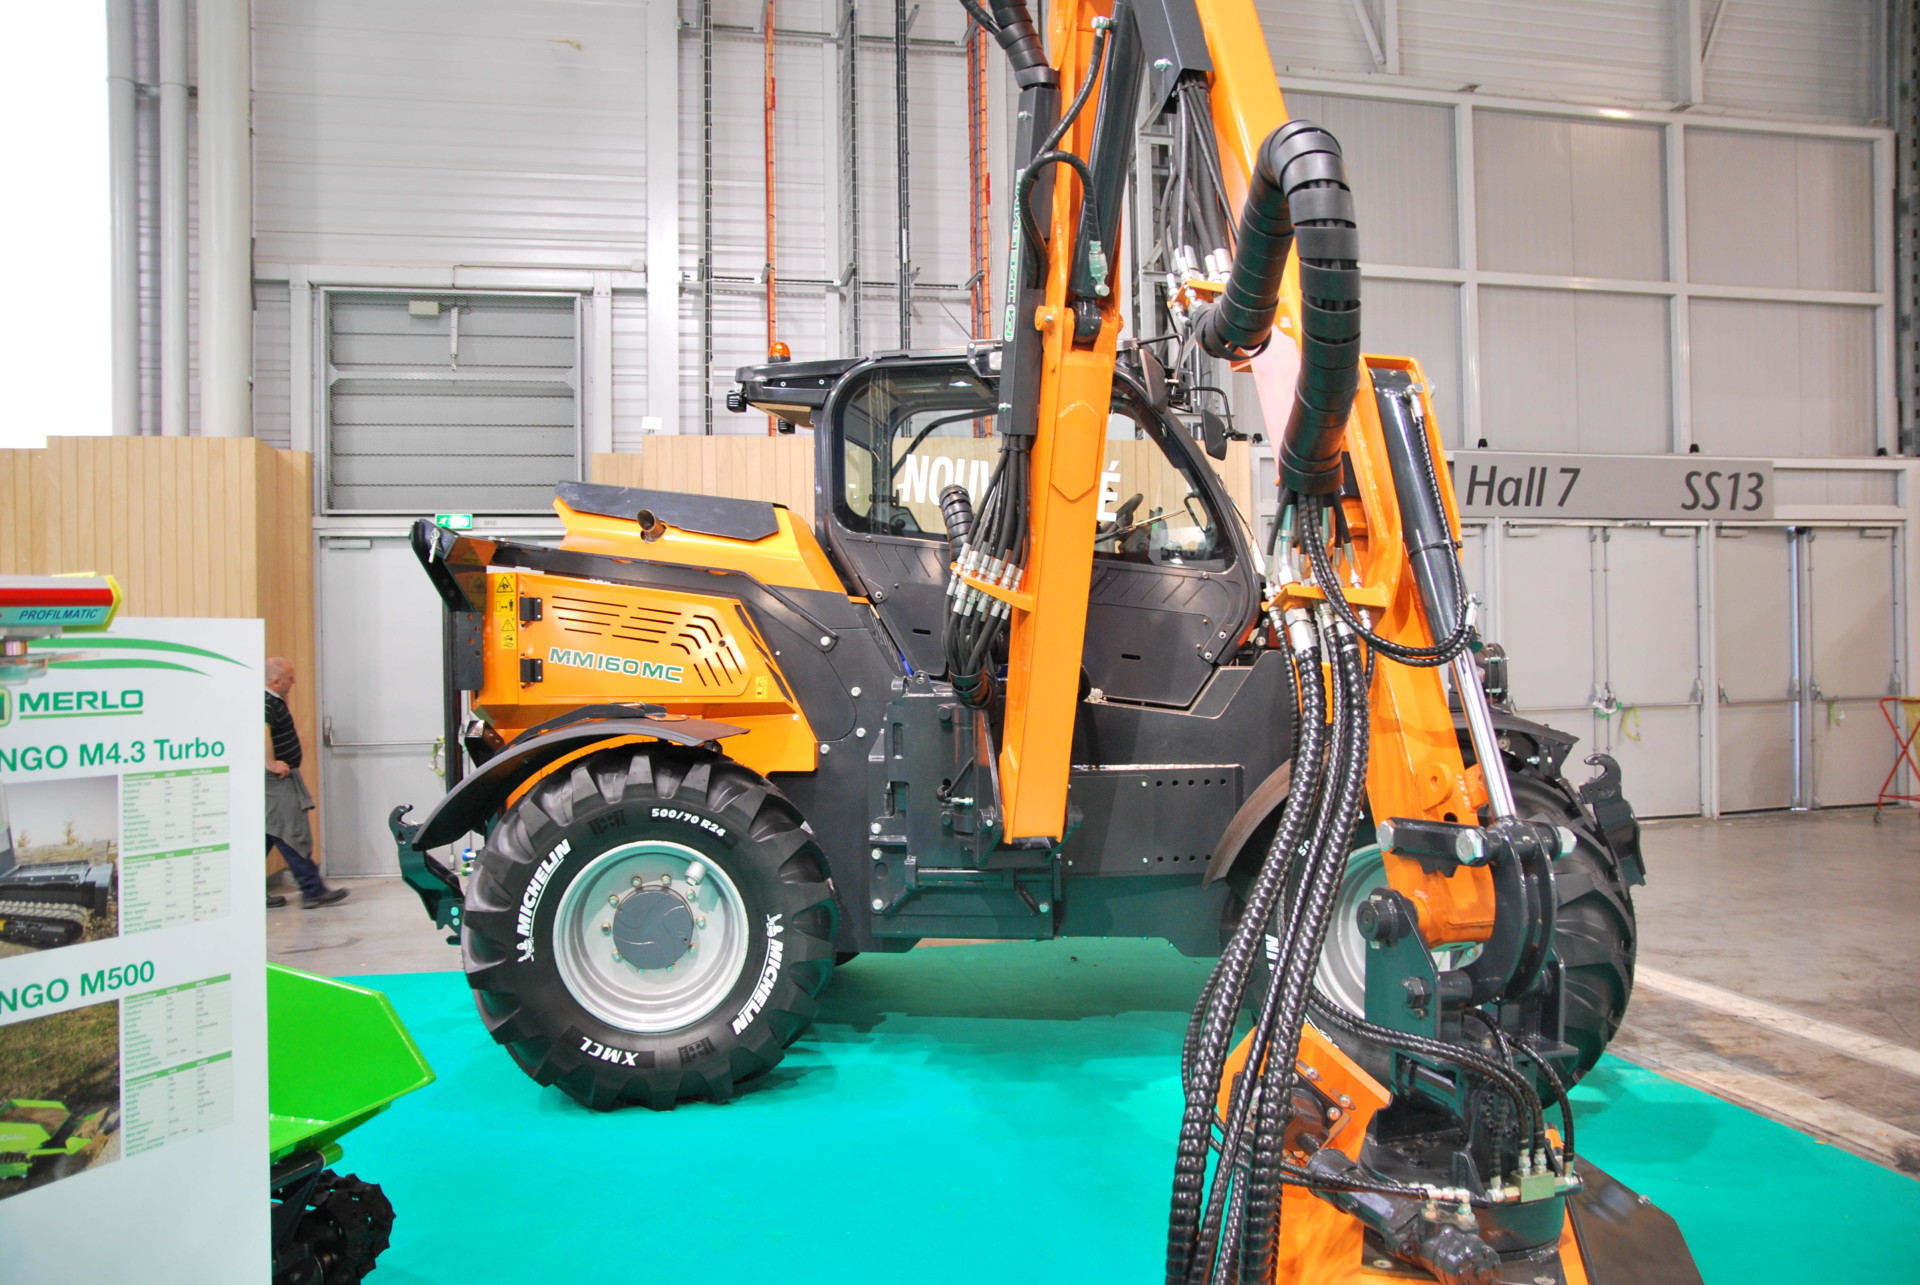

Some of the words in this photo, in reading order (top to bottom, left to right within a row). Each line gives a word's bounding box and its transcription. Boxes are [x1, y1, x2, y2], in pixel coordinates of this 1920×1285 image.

[1466, 465, 1547, 507] Hall
[1557, 467, 1581, 507] 7
[1681, 471, 1764, 511] SS13
[19, 608, 98, 621] PROFILMATIC
[19, 690, 143, 713] MERLO
[79, 740, 146, 767] M4.3
[154, 737, 225, 761] Turbo
[651, 808, 700, 824] 500/70
[700, 819, 727, 837] R24
[516, 839, 572, 936] MICHELIN
[80, 960, 154, 997] M500
[732, 939, 784, 1035] MICHELIN
[579, 1036, 640, 1067] XMCL
